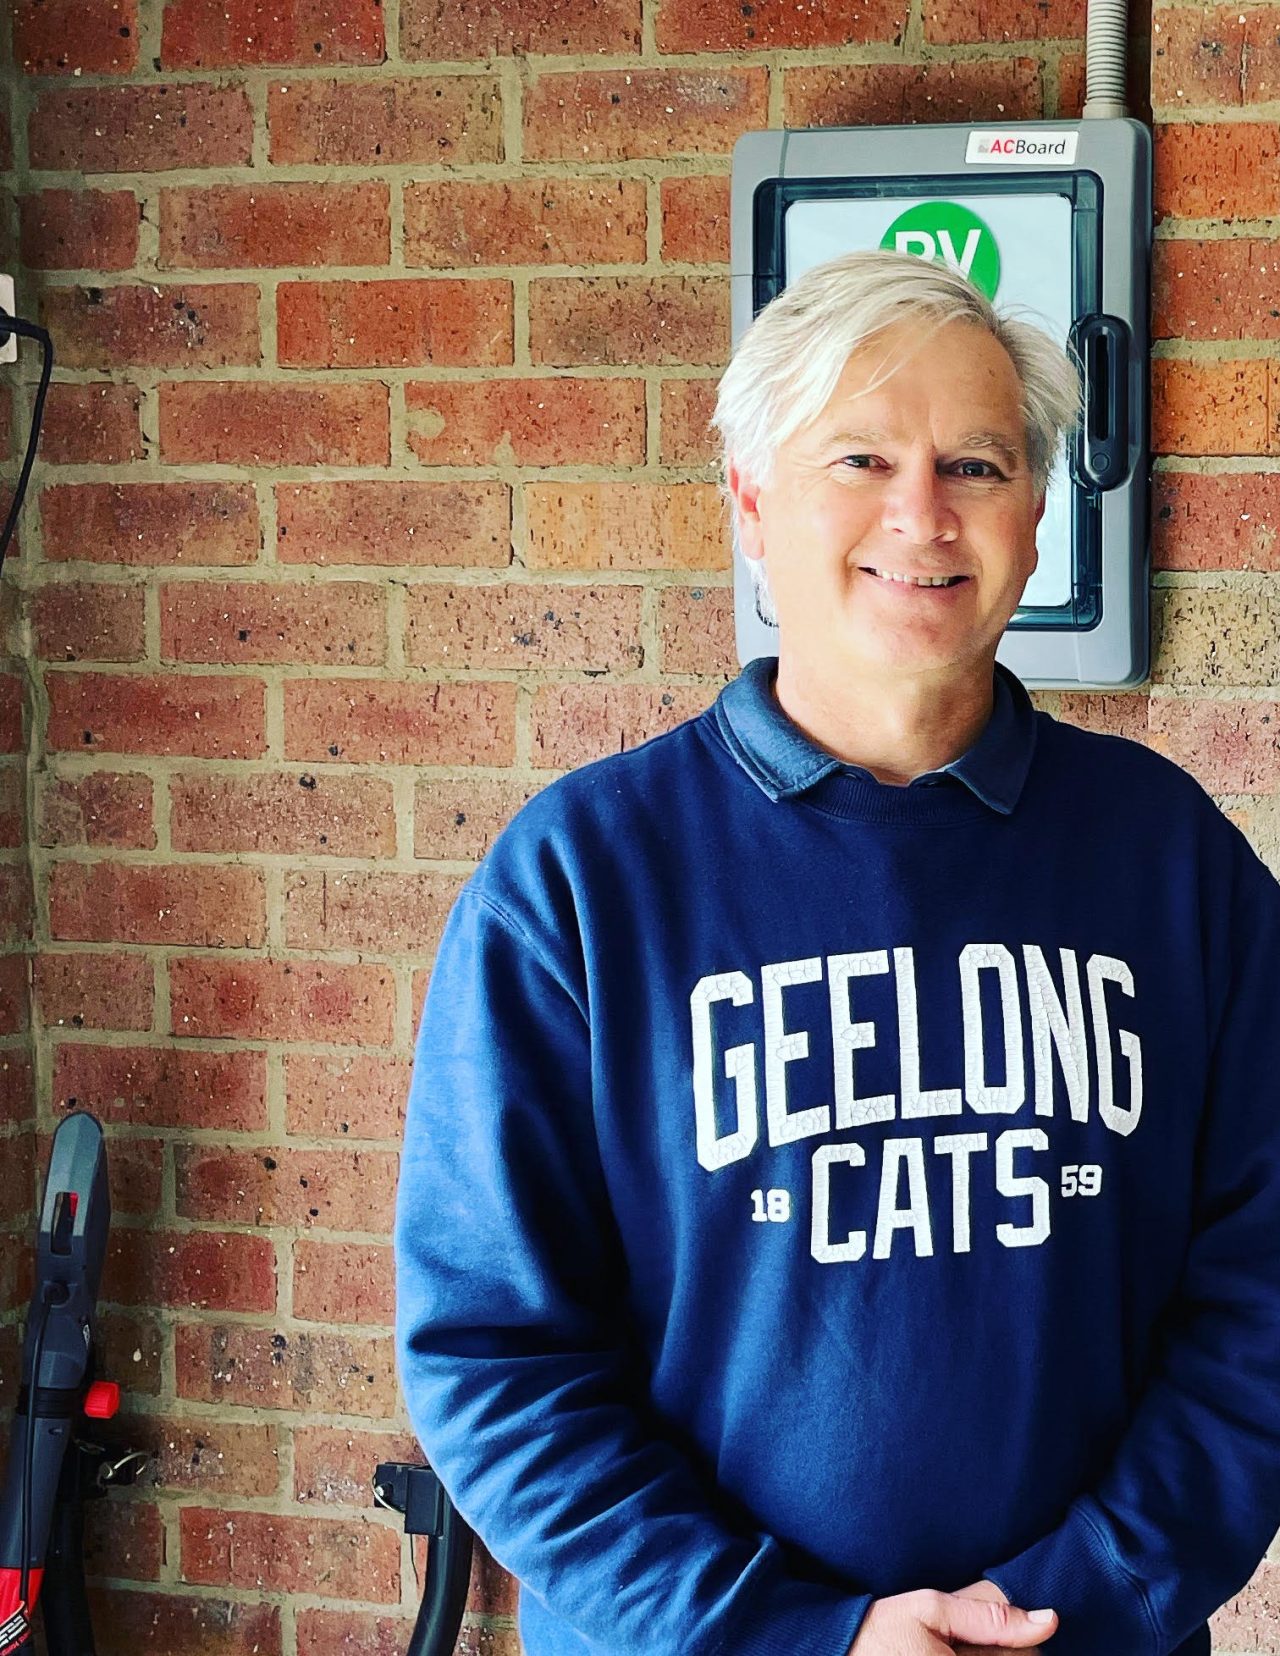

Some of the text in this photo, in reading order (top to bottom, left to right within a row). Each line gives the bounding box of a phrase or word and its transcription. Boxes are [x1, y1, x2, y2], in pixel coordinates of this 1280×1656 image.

[990, 138, 1066, 155] ACBoard
[690, 943, 1143, 1172] GEELONG
[751, 1128, 1102, 1264] 18 CATS 59
